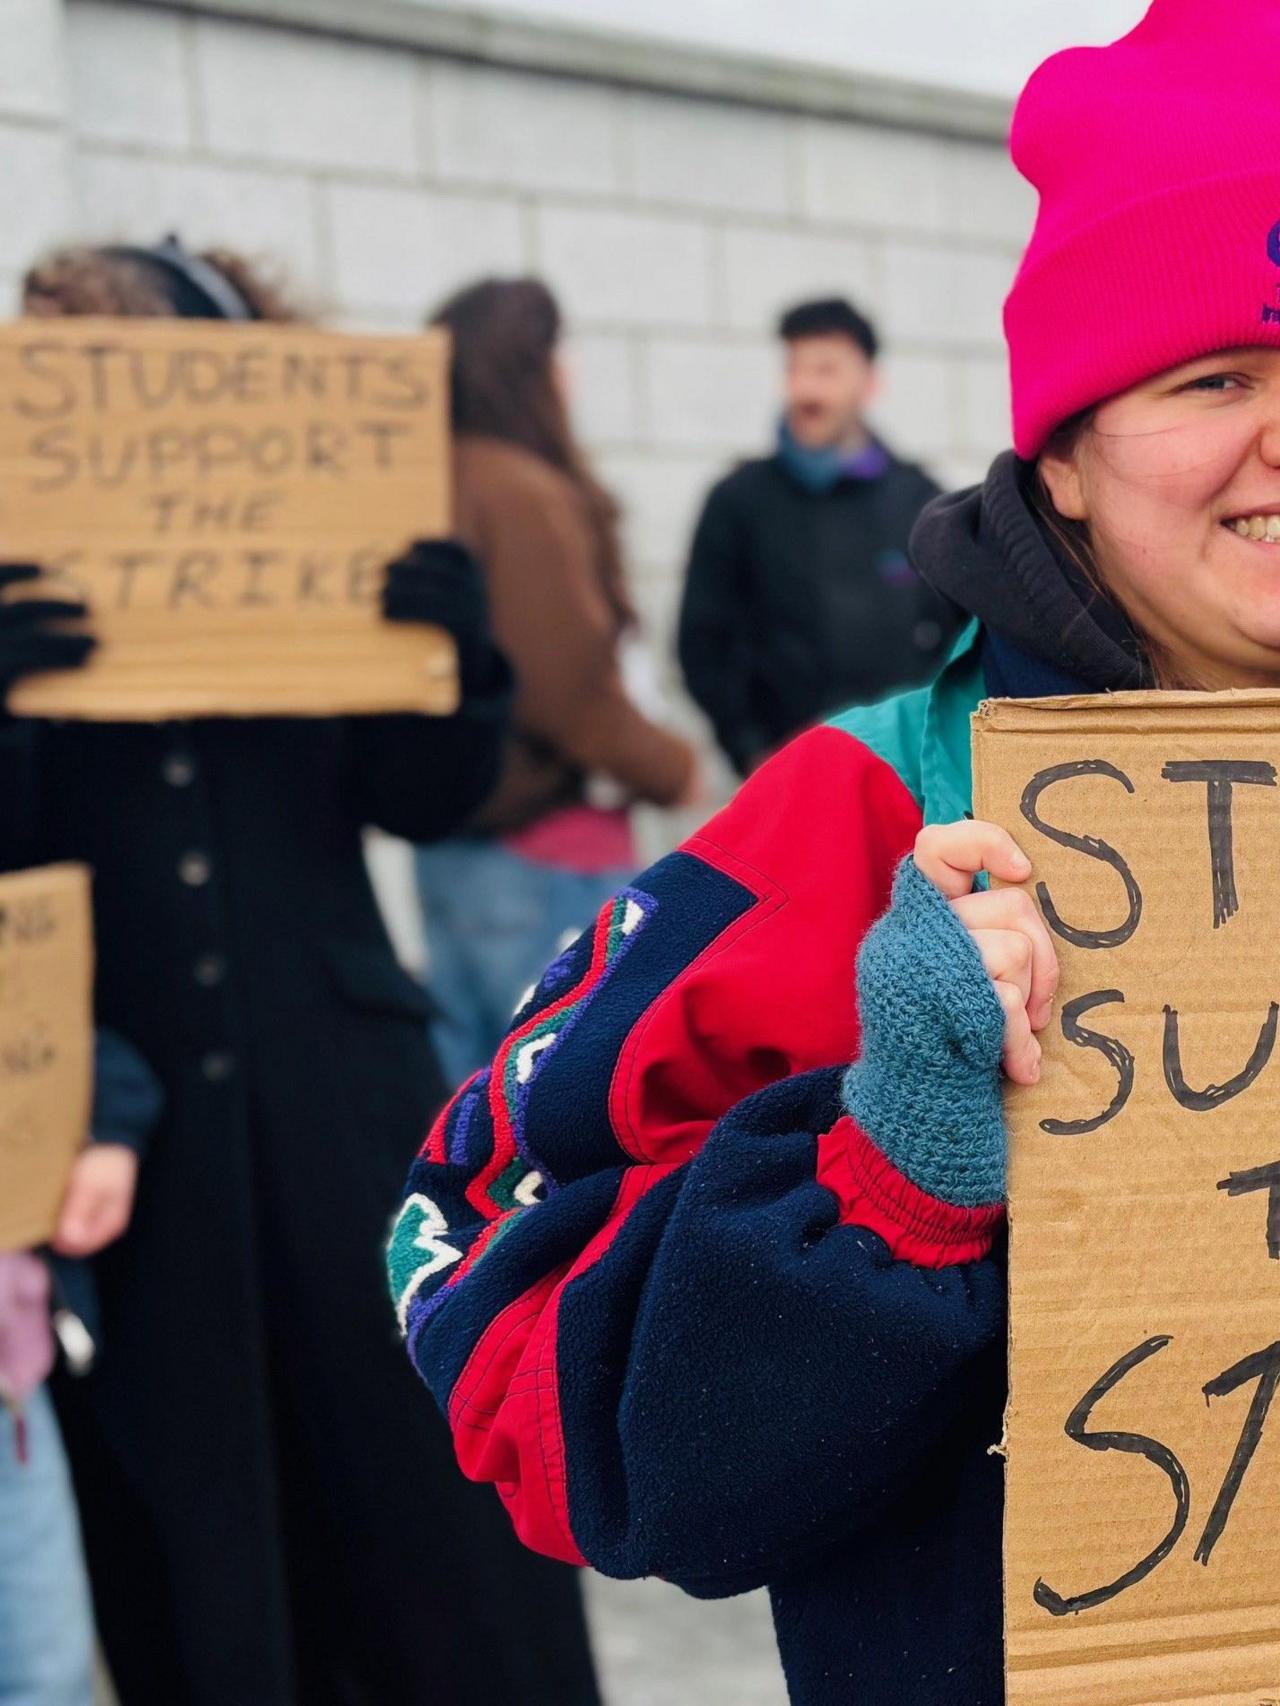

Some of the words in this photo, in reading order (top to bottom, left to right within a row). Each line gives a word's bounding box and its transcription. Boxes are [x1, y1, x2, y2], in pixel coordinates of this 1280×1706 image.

[14, 340, 430, 420] STUDENTS
[28, 423, 409, 492] SUPPORT
[142, 490, 284, 533] THE
